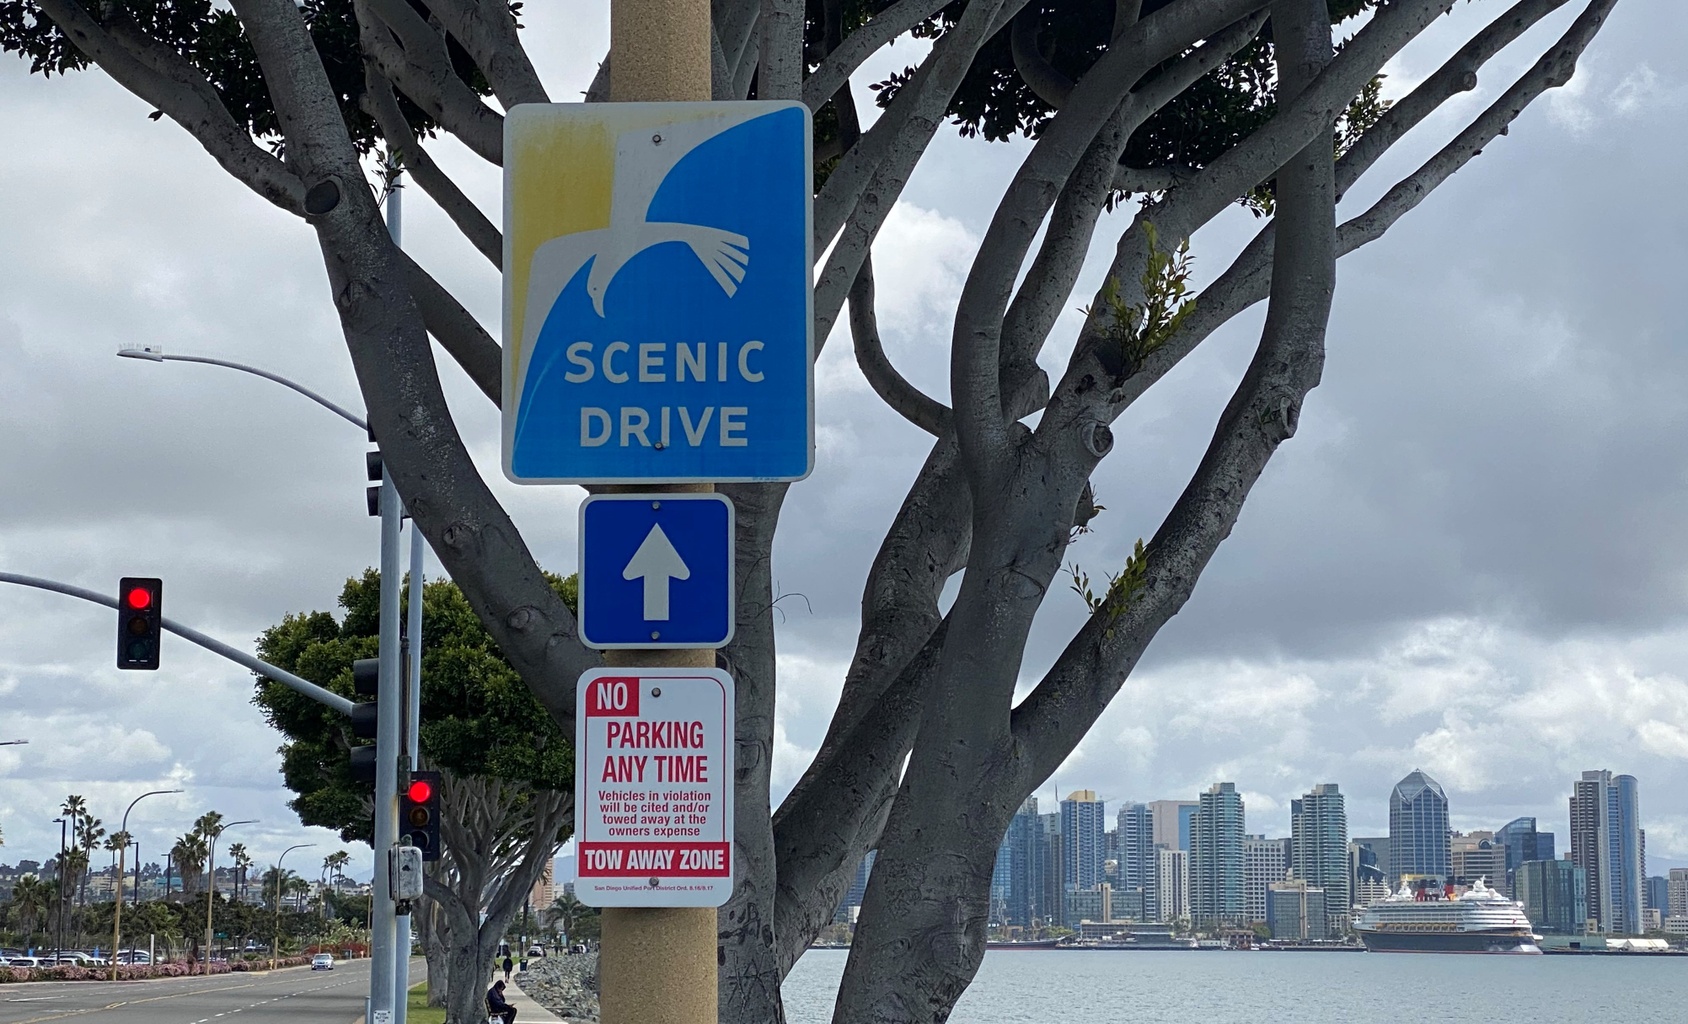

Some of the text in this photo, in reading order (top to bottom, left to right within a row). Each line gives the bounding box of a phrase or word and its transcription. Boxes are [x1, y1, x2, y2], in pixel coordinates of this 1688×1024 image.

[564, 340, 765, 383] SCENIC
[580, 406, 748, 447] DRIVE
[597, 682, 628, 710] NO
[607, 721, 704, 749] PARKING
[602, 756, 708, 783] ANY TIME
[598, 790, 711, 801] Vehicles in violation
[600, 802, 710, 813] will be cited and/or
[603, 814, 707, 827] towed away at the
[608, 827, 700, 838] owners expense
[584, 849, 724, 870] TOW AWAY ZONE
